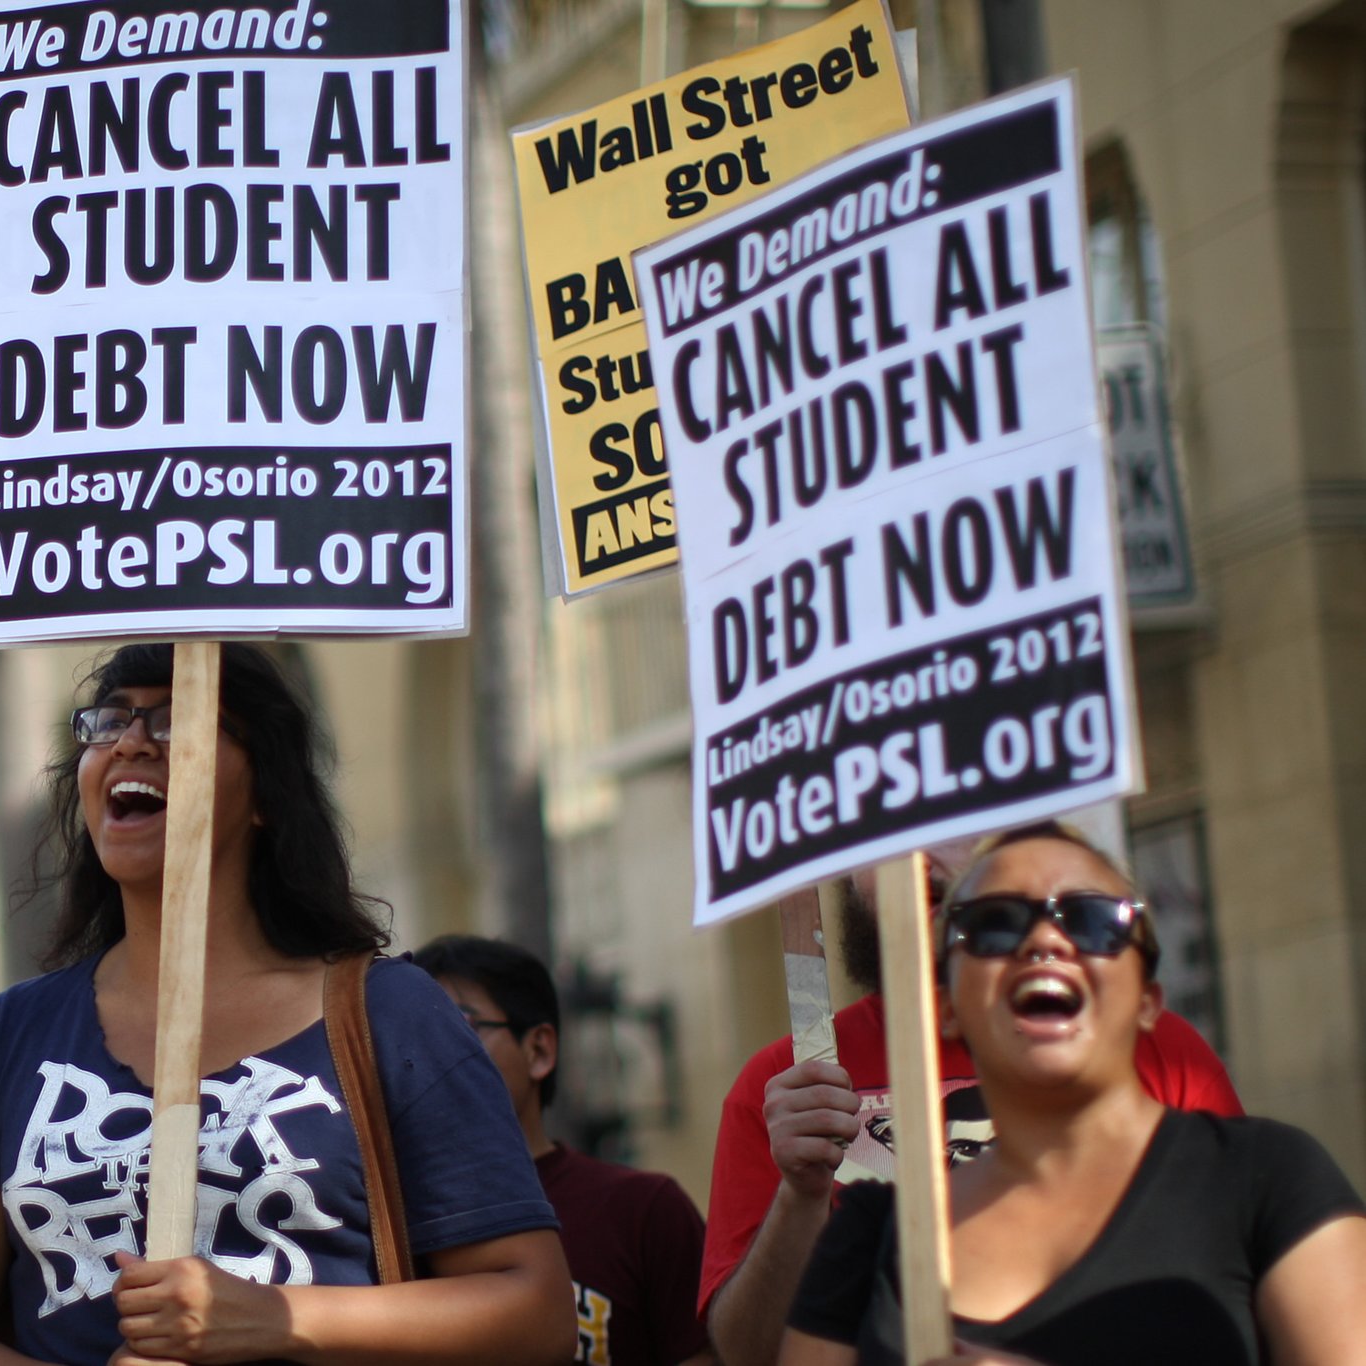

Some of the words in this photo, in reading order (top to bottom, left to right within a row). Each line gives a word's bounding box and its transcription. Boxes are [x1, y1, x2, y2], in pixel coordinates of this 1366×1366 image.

[80, 0, 328, 61] Demand:
[307, 66, 450, 168] ALL
[535, 92, 672, 194] Wall
[681, 25, 879, 140] Street
[666, 135, 771, 219] got
[31, 182, 401, 295] STUDENT
[546, 257, 640, 340] BA
[659, 259, 725, 327] We
[738, 149, 941, 293] Demand:
[227, 322, 437, 425] NOW
[672, 246, 908, 443] CANCEL
[934, 190, 1071, 331] ALL
[333, 458, 447, 498] 2012
[724, 322, 1024, 548] STUDENT
[712, 537, 855, 705] DEBT
[881, 465, 1077, 629] NOW
[708, 651, 977, 786] Lindsay/Osorio
[989, 613, 1102, 681] 2012
[710, 694, 1111, 872] VotePSL.org
